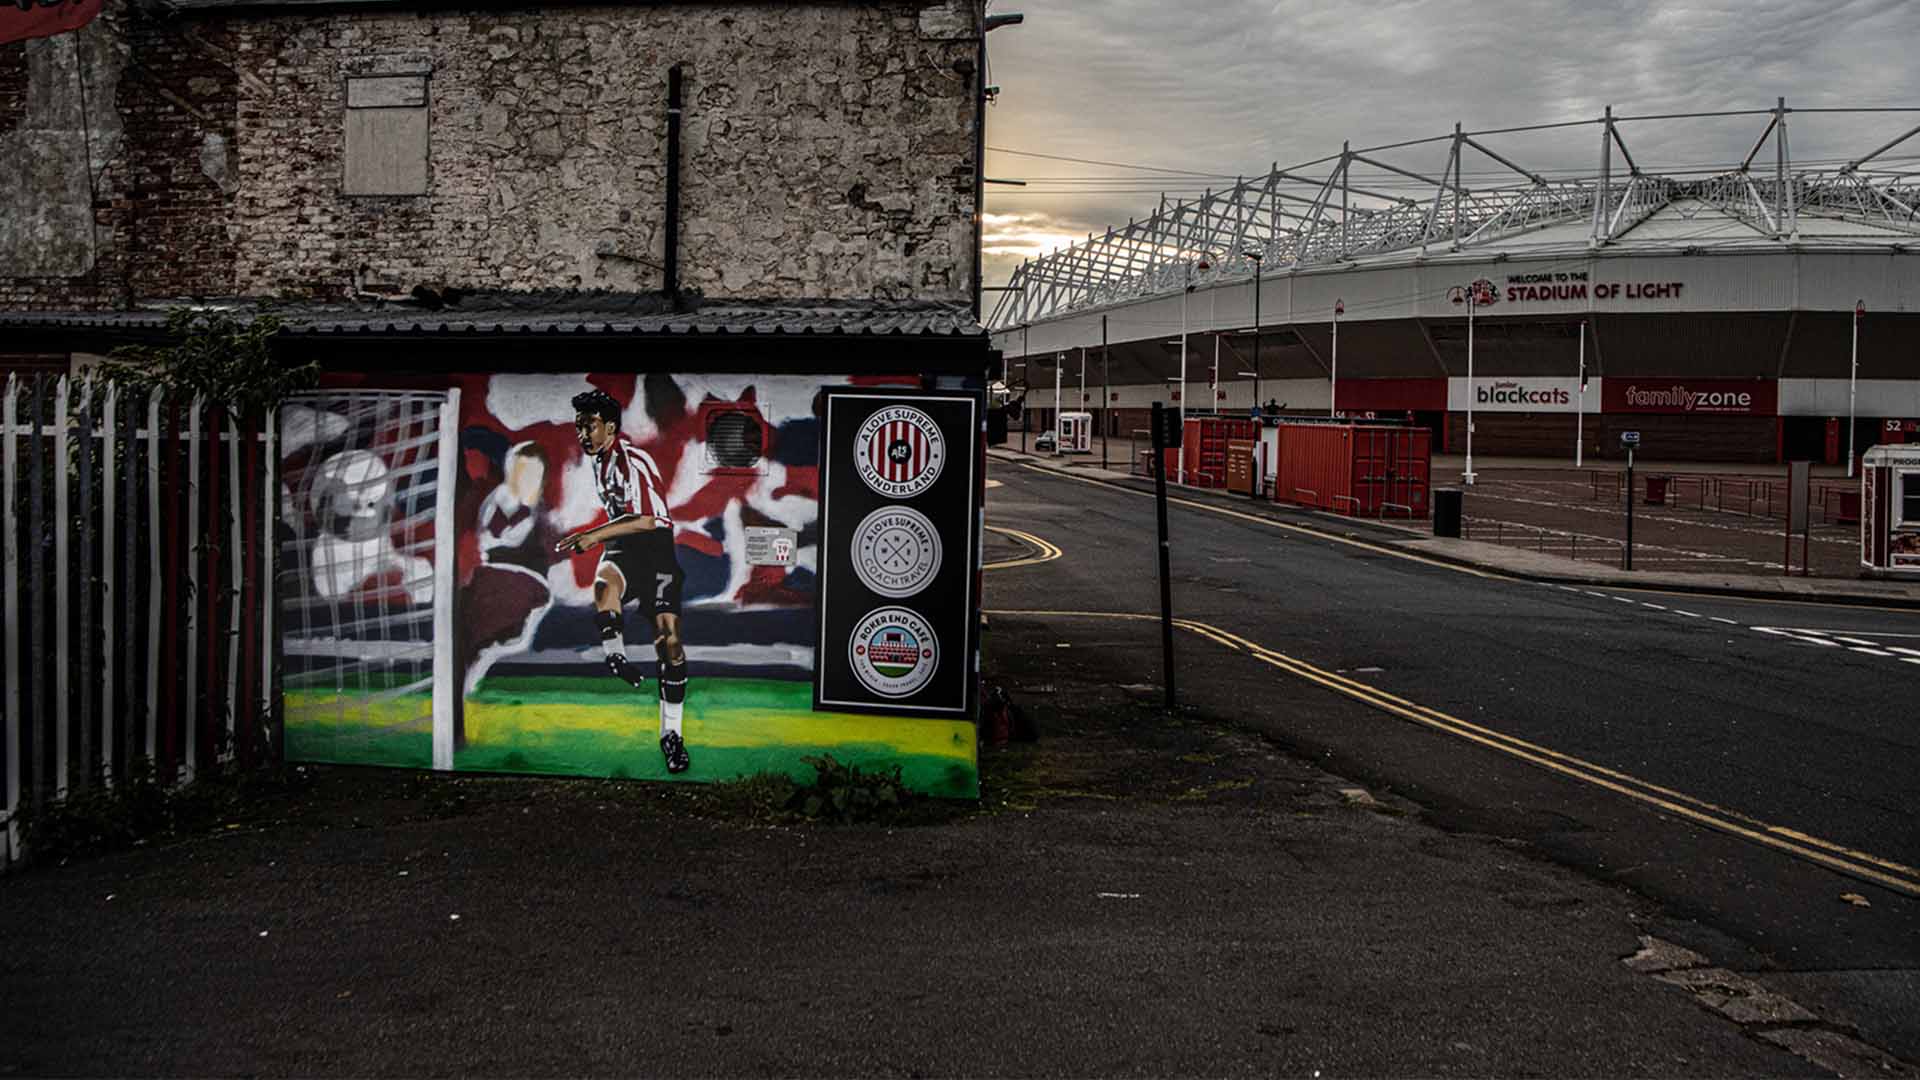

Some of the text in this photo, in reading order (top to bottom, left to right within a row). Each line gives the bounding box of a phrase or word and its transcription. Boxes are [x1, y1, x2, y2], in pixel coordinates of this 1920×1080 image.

[1507, 272, 1588, 283] WELCOME TO THE
[1507, 283, 1684, 301] STADIUM OF LIGHT
[1477, 386, 1569, 404] blackcats
[1625, 385, 1752, 410] familyzone
[862, 410, 939, 444] A LOVE SUPREME
[1886, 420, 1901, 432] 52
[862, 465, 936, 494] SUNDERLAND
[873, 517, 892, 535] LOVE
[895, 517, 929, 545] SUPREME
[865, 558, 928, 585] COACH TRAVEL
[656, 573, 673, 599] 7
[860, 615, 888, 640] ROKER
[888, 614, 909, 625] END
